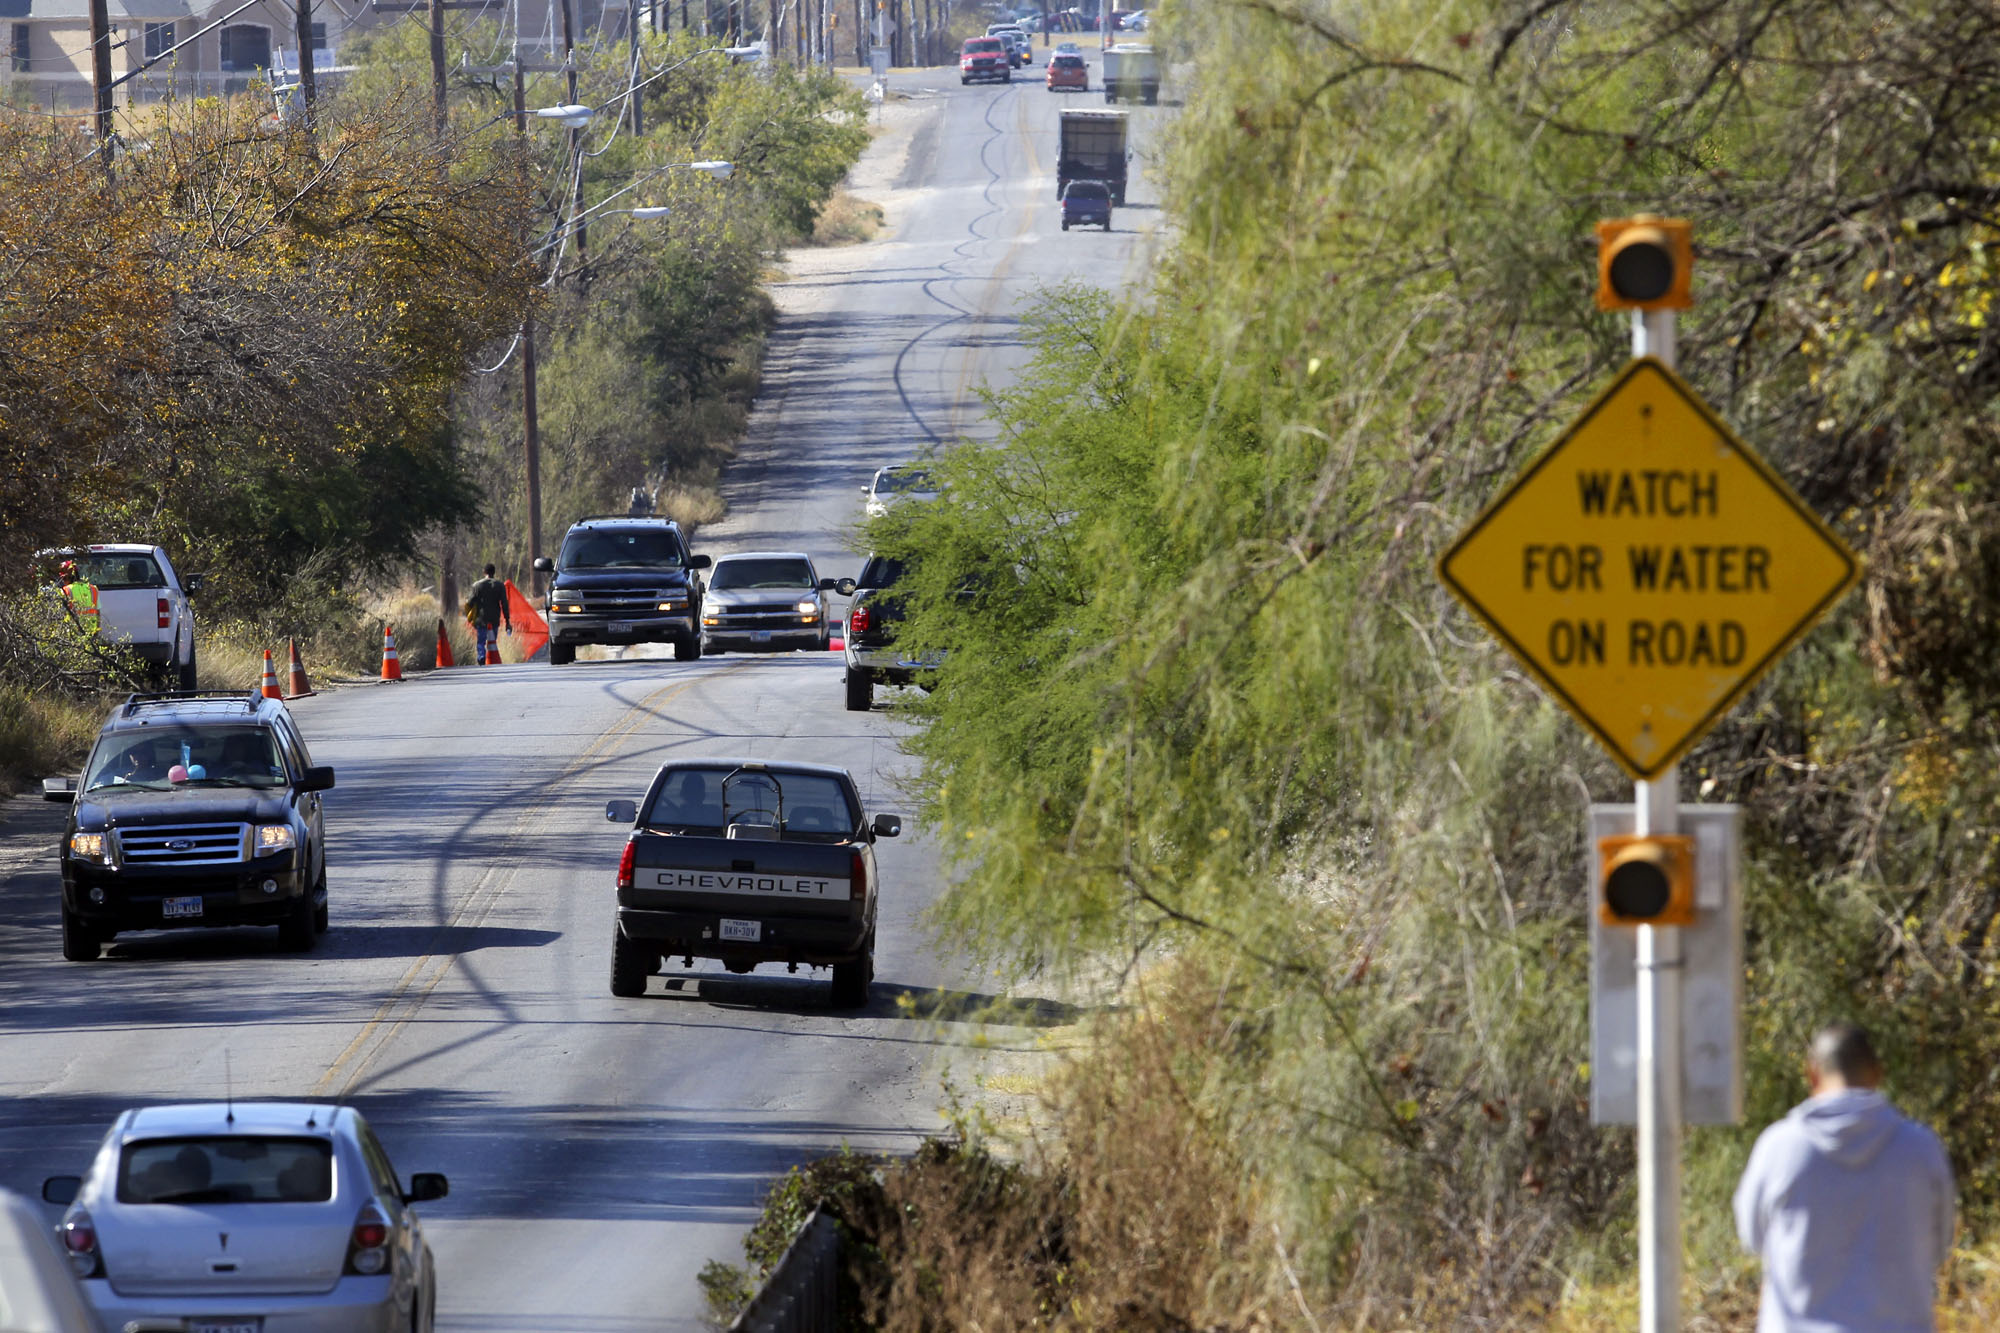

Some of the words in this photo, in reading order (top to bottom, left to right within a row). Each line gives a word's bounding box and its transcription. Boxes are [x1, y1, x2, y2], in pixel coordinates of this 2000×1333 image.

[1577, 470, 1717, 517] WATCH
[1523, 544, 1603, 592] FOR
[1628, 545, 1771, 593] WATER
[1548, 620, 1606, 667] ON
[1628, 620, 1747, 667] ROAD
[657, 873, 829, 894] CHEVROLET
